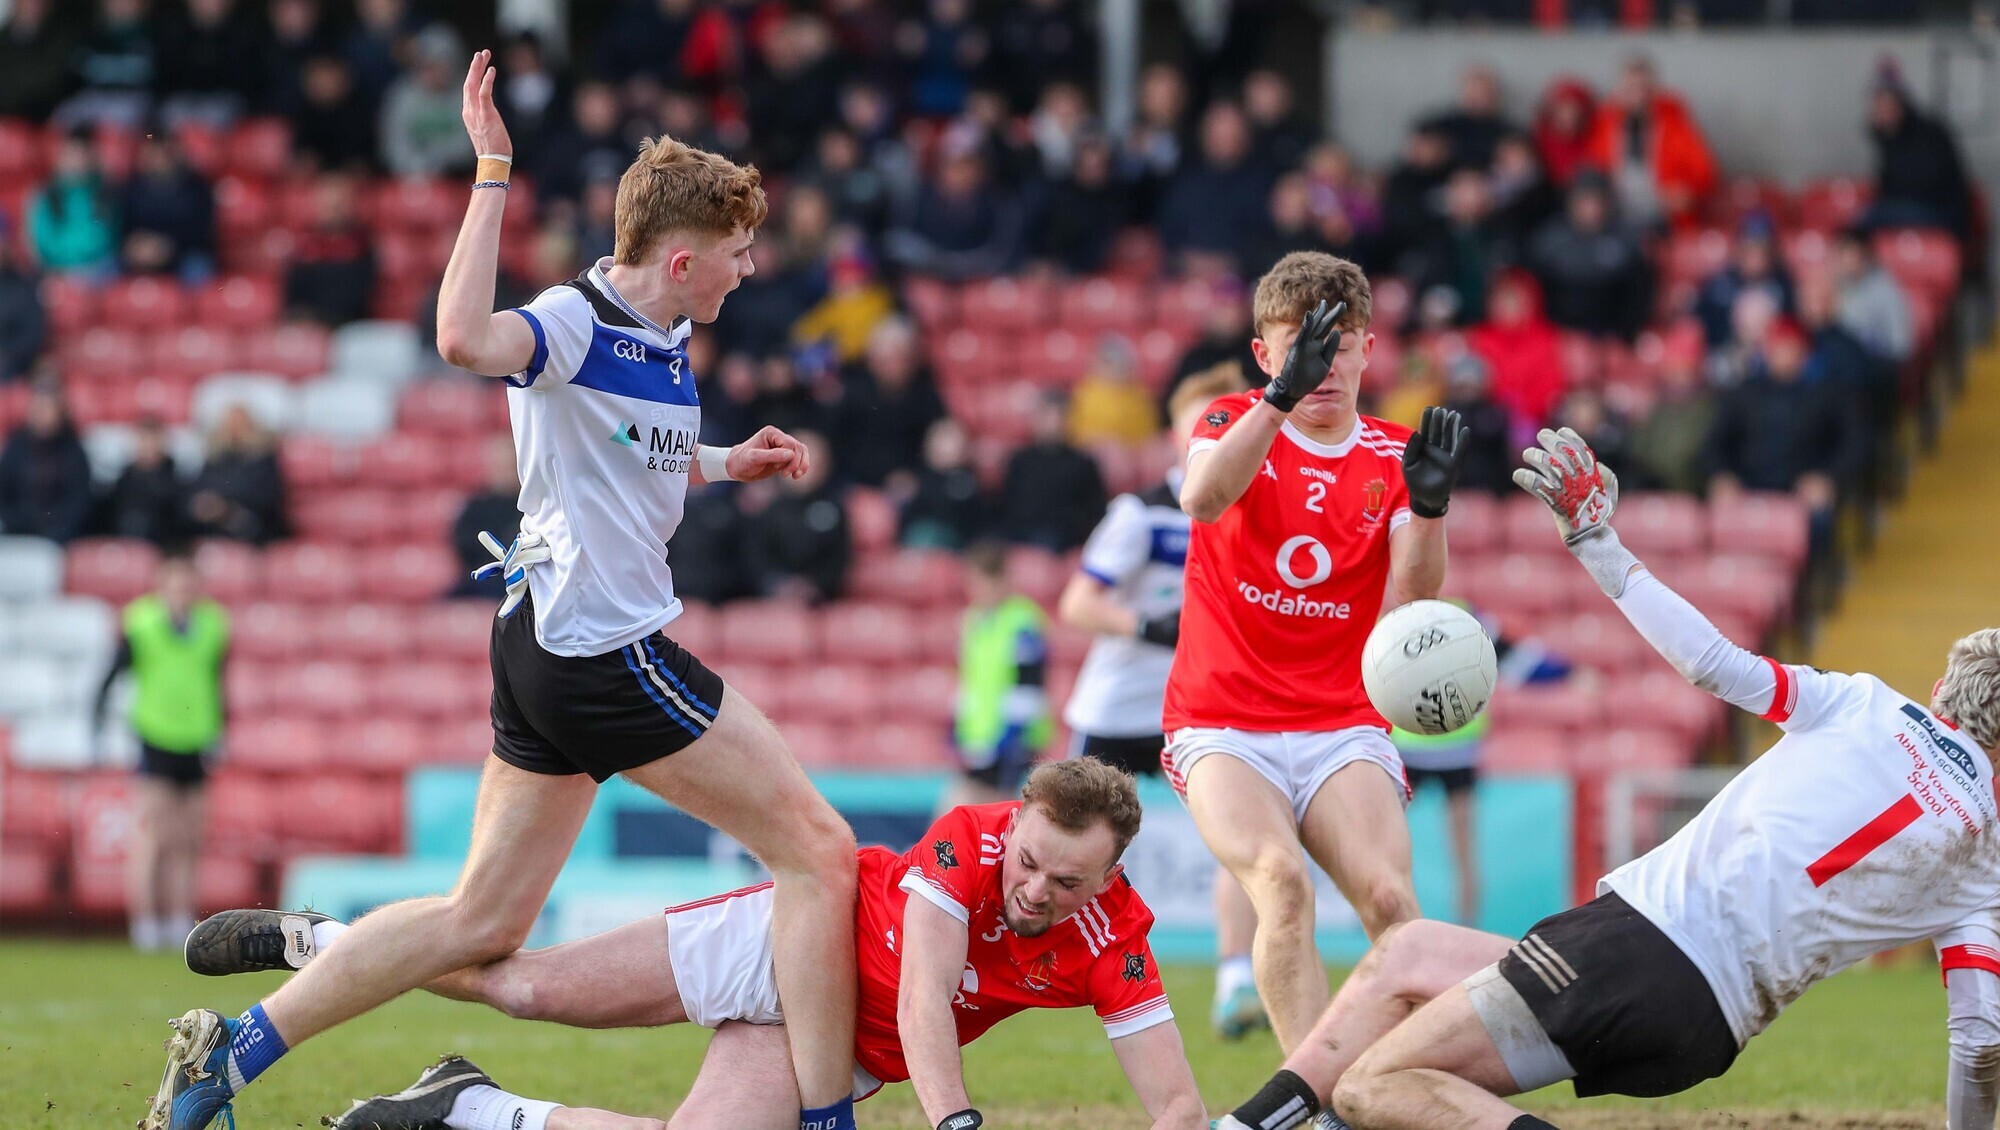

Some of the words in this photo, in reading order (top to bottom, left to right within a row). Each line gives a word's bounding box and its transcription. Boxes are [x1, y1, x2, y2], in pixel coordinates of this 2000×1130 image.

[669, 358, 682, 384] 9
[647, 456, 657, 470] &
[661, 459, 677, 472] CO
[1300, 466, 1337, 484] oneills
[1305, 482, 1326, 514] 2
[1905, 721, 1938, 759] ULSTER
[1936, 758, 1980, 802] SCHOOLS
[1894, 732, 1928, 770] Abbey
[1928, 770, 1982, 837] Vocational
[1907, 771, 1948, 818] School
[1805, 792, 1925, 889] 1
[294, 930, 305, 953] PUMA
[982, 916, 1009, 942] 3
[514, 1112, 526, 1130] NIK
[949, 1115, 975, 1130] STRIVE
